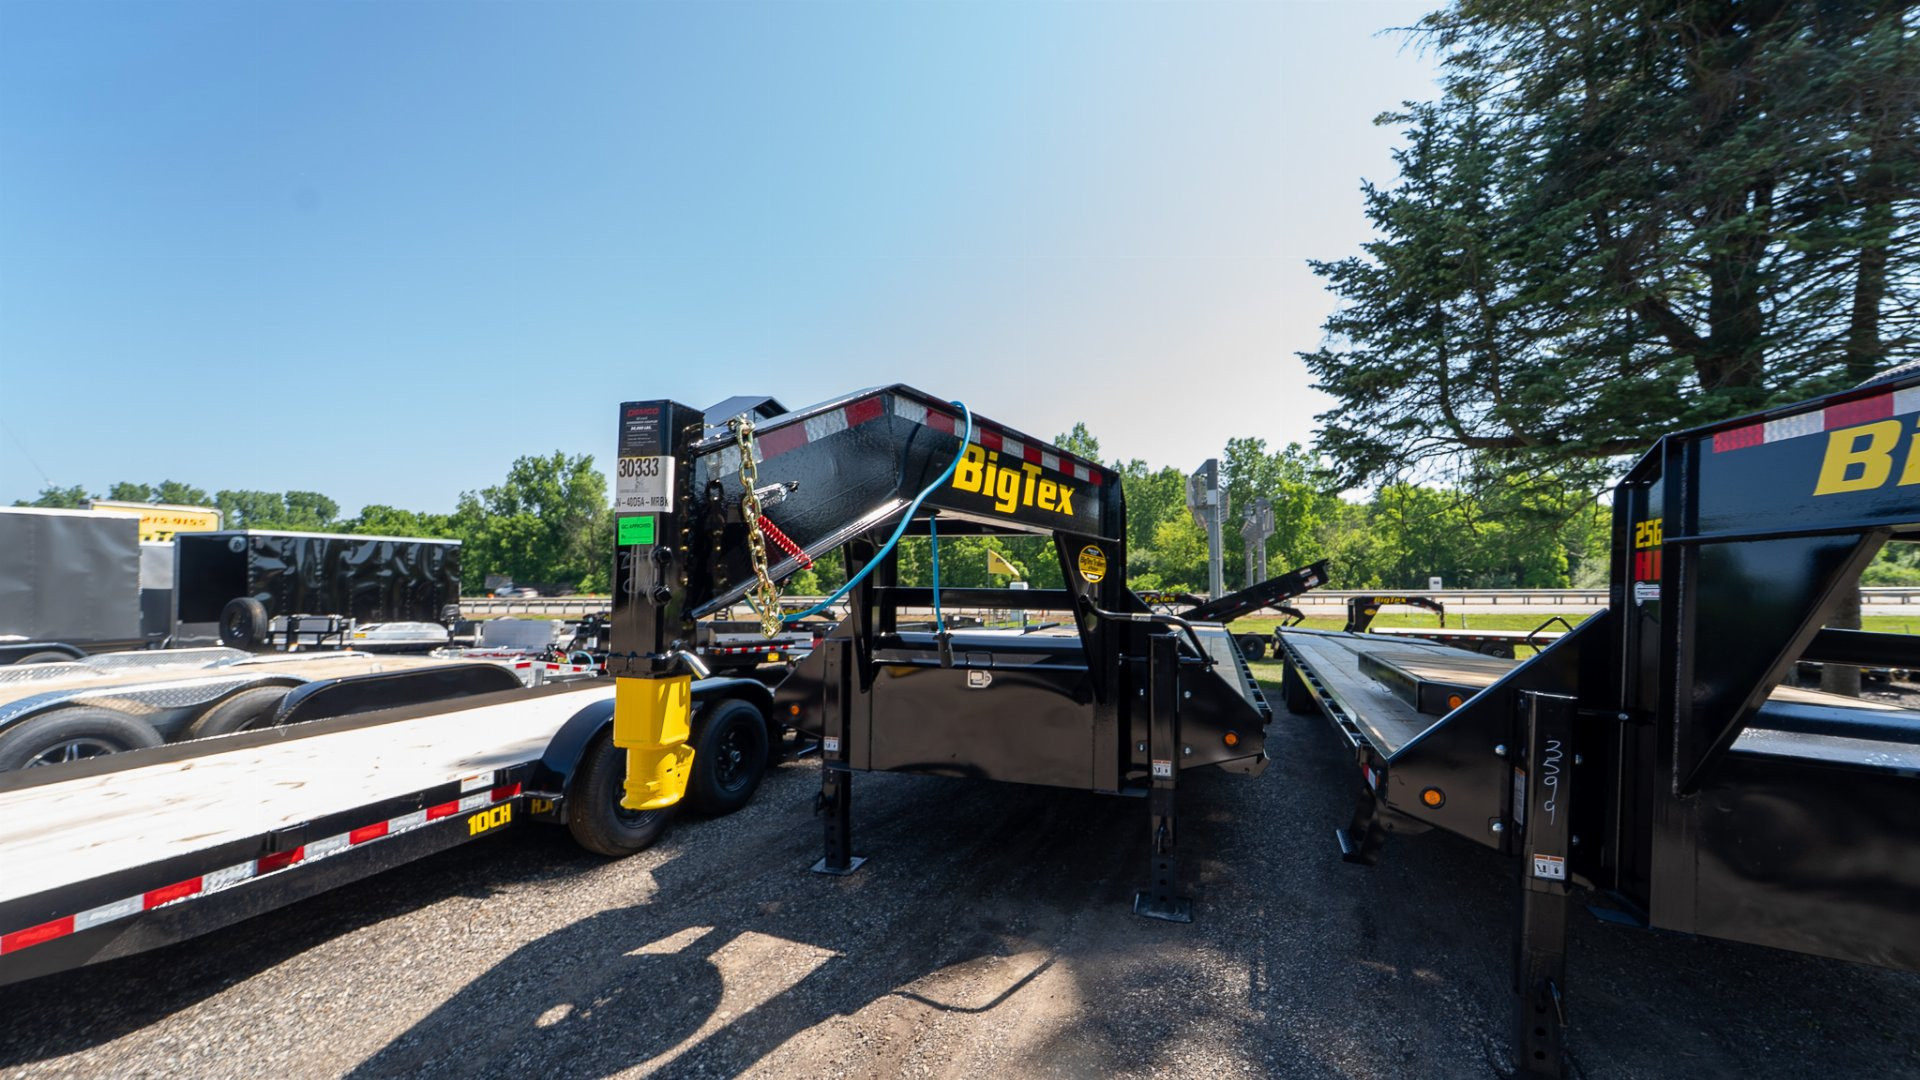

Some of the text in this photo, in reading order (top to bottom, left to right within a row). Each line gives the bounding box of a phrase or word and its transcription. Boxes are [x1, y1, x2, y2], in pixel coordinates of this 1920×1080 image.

[619, 457, 660, 478] 30333
[952, 440, 1075, 516] BigTex
[467, 802, 512, 837] 10CH
